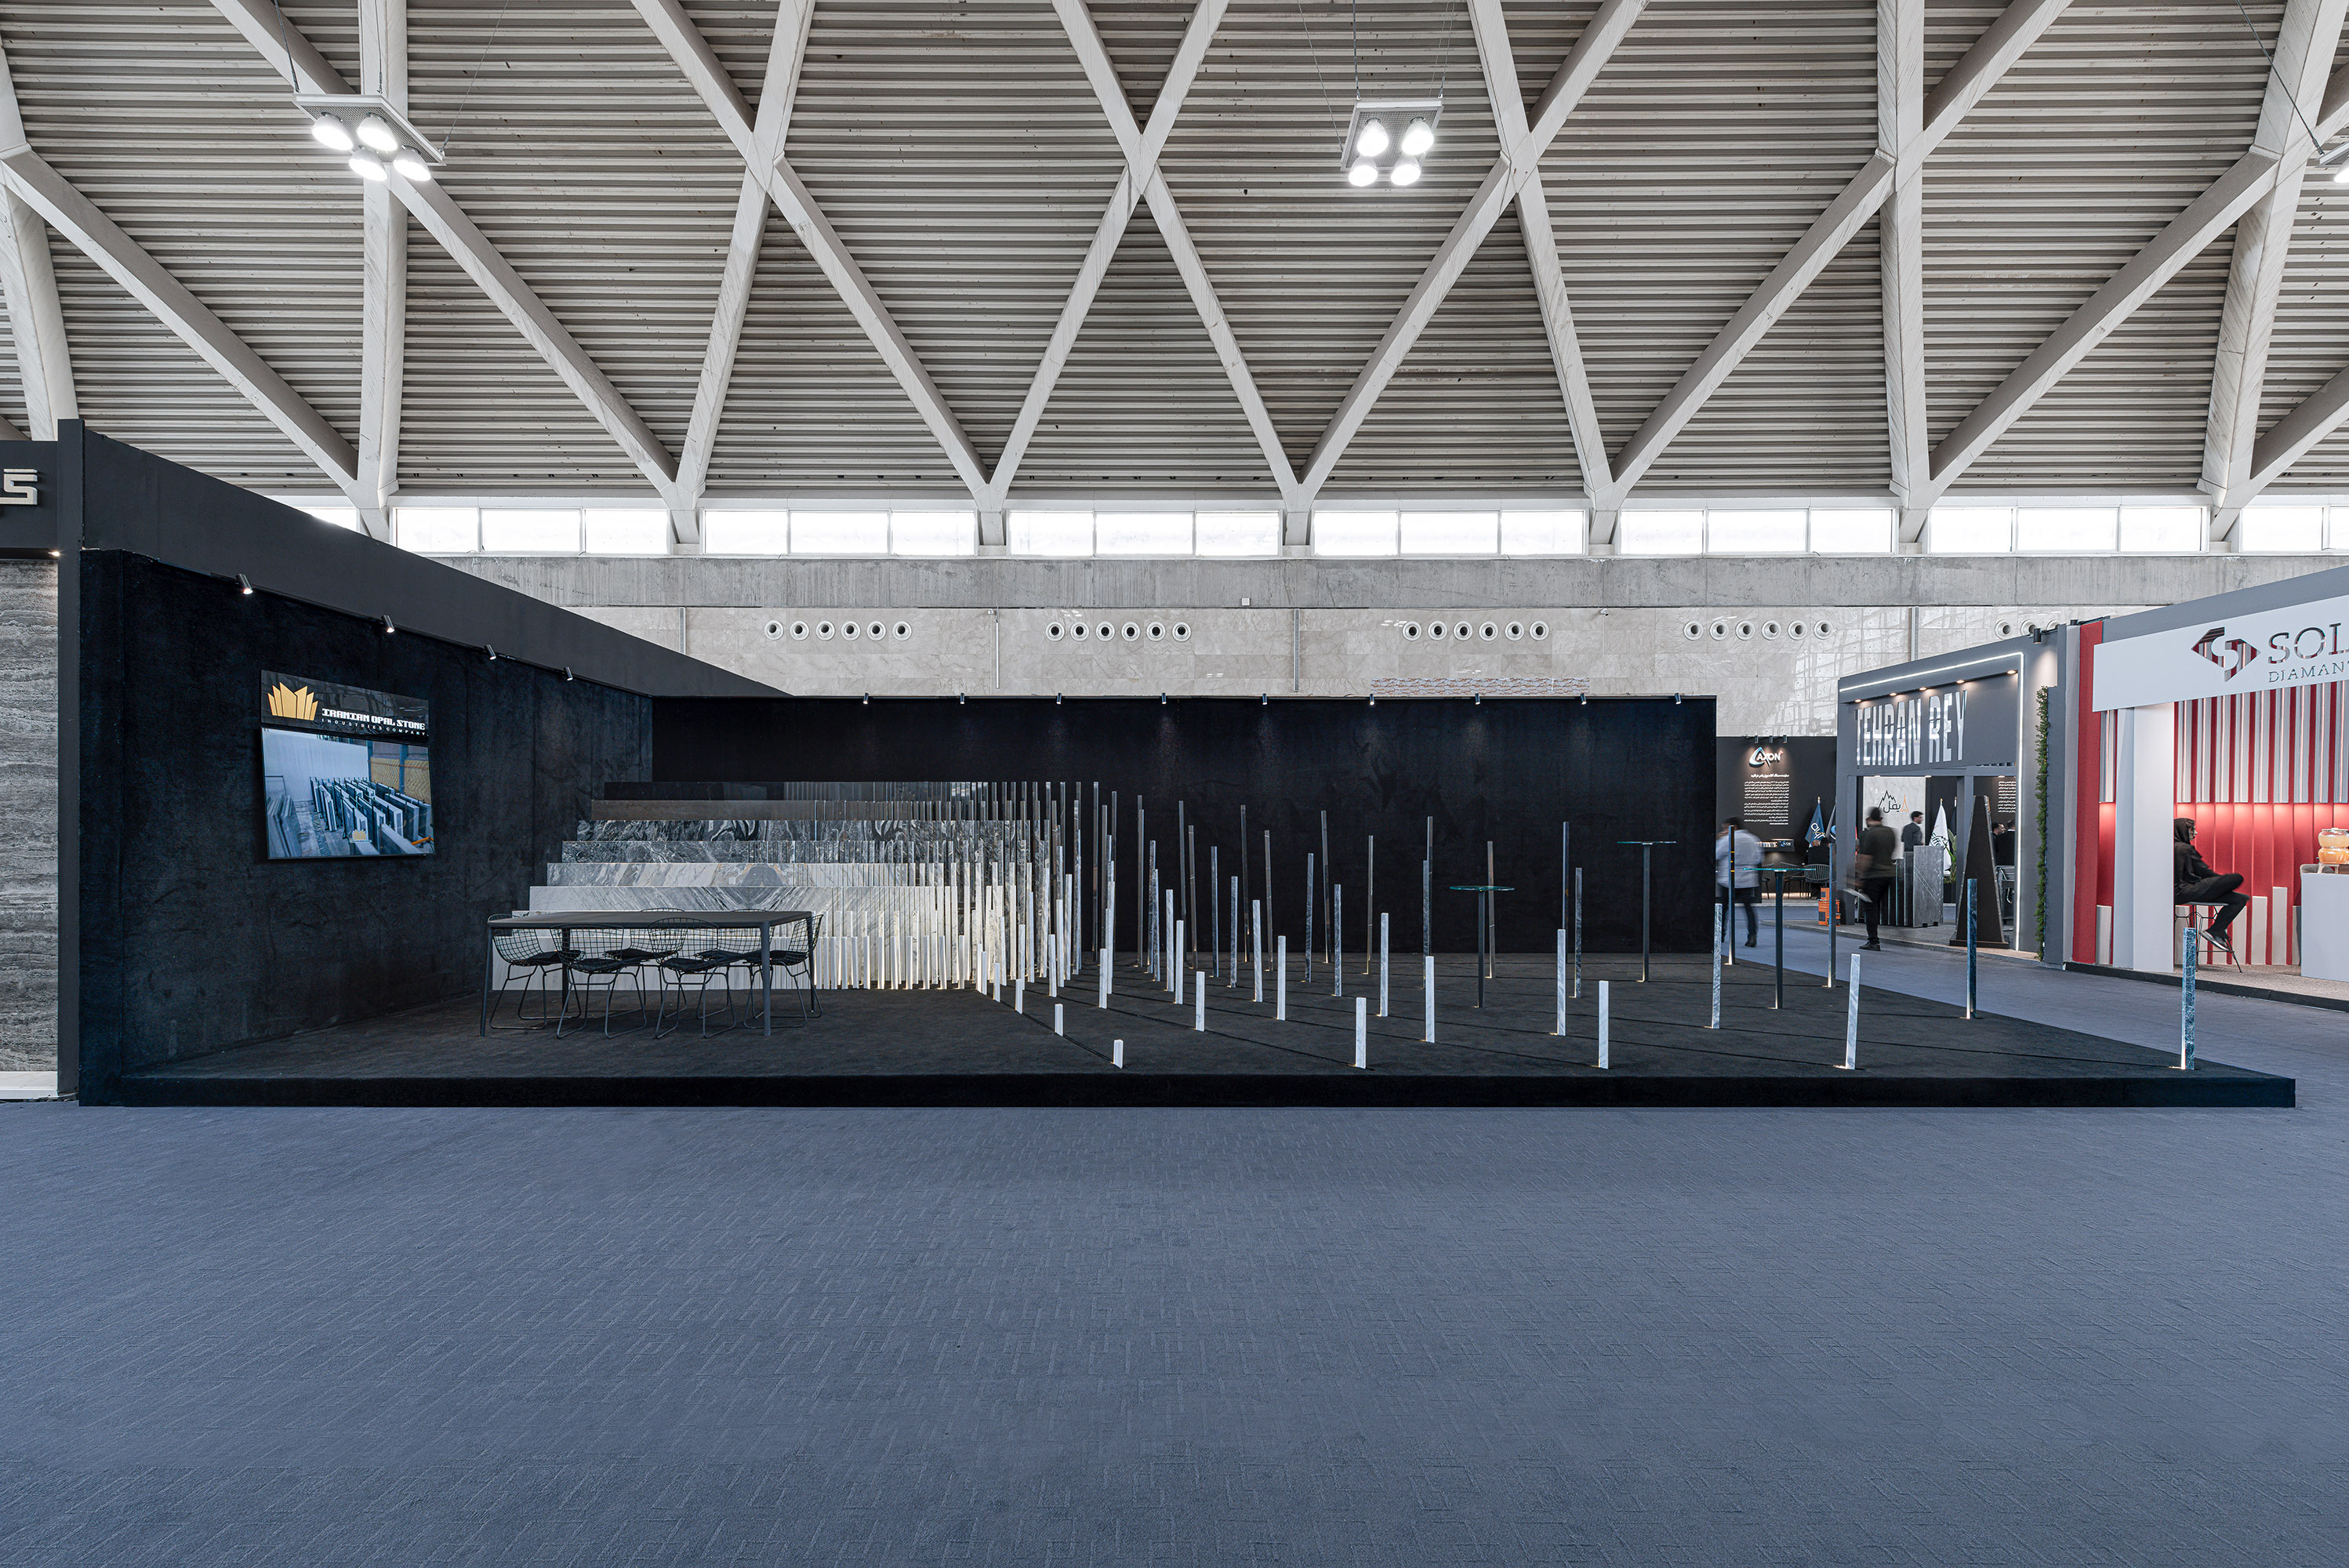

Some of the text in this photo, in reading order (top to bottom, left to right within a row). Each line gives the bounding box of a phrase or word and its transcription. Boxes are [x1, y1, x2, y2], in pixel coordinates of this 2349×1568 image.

[2268, 660, 2349, 683] DIAMAN
[321, 708, 426, 731] IRANIAN OPAL STONE
[321, 718, 426, 736] INDUSTRIES COMPANY
[1854, 689, 1968, 766] TEHRAN REY
